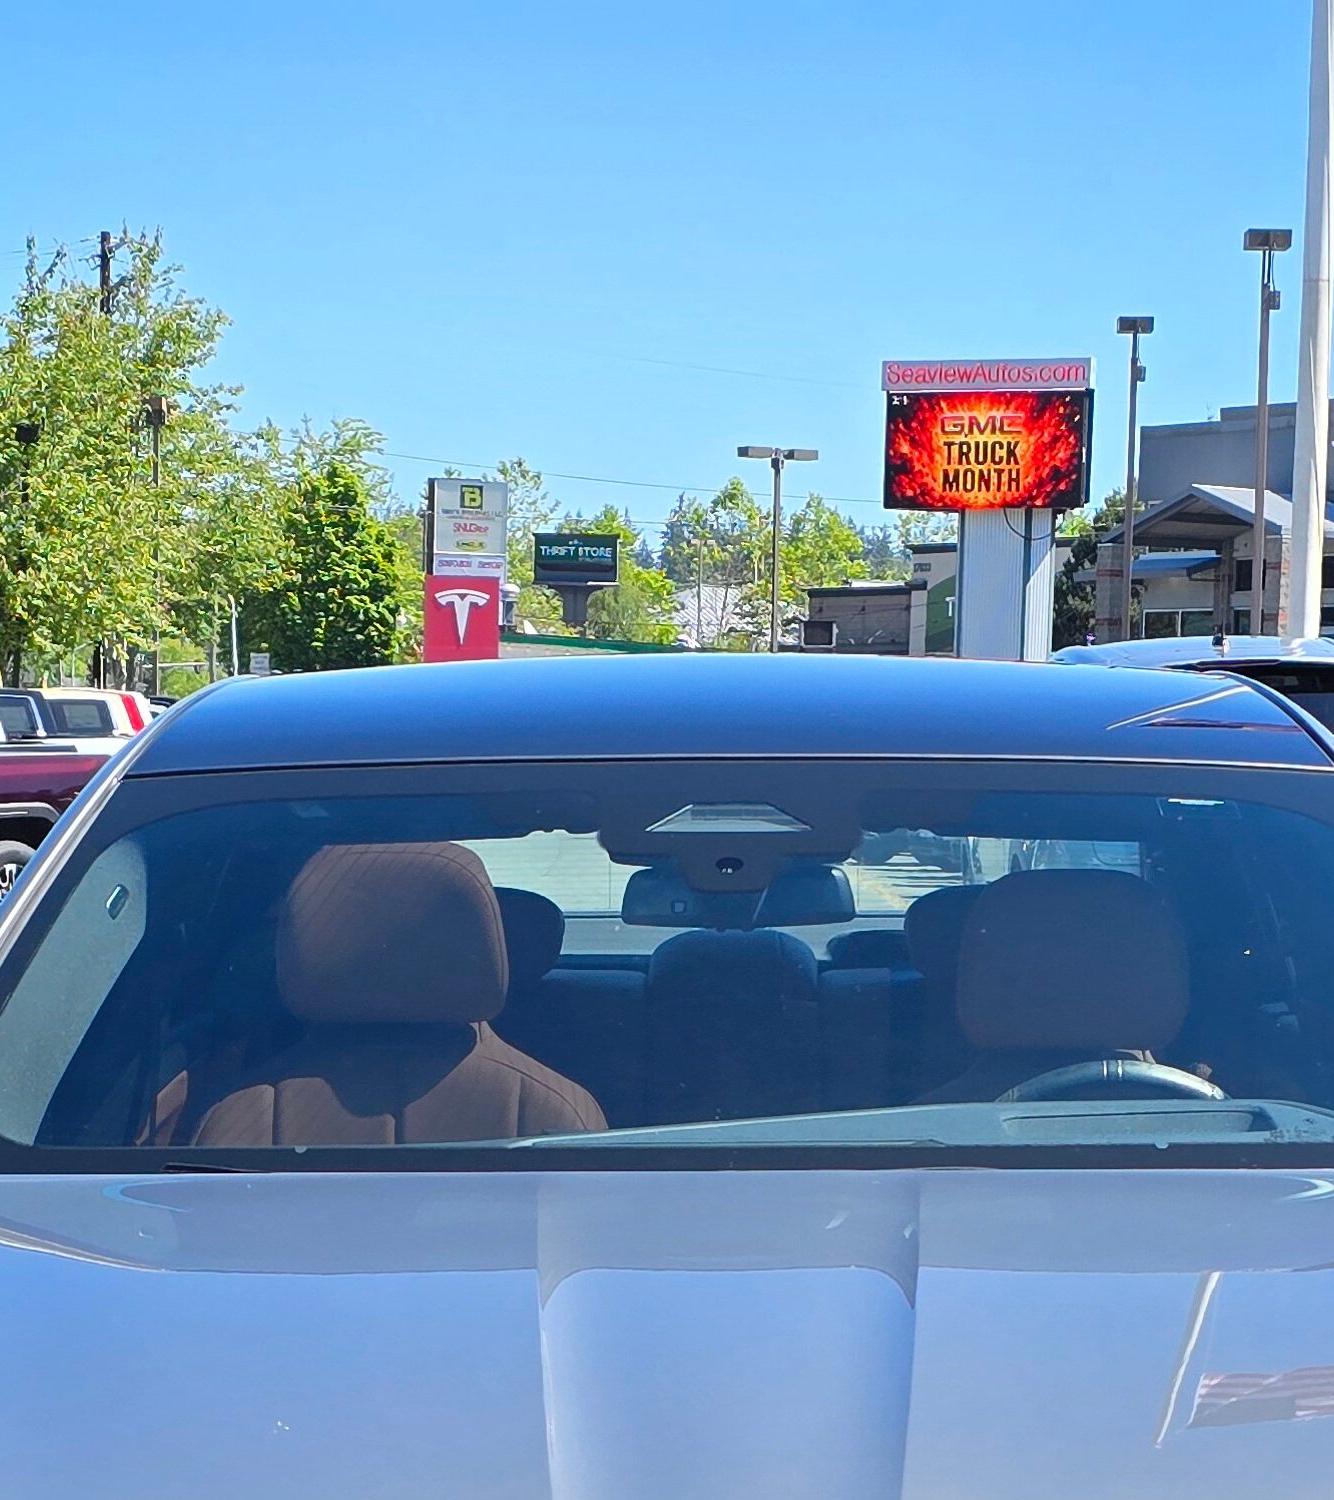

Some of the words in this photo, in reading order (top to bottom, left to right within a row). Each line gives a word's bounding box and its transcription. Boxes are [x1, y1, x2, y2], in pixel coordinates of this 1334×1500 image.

[886, 362, 1087, 385] SeaviewAutos.com
[939, 415, 1023, 435] GMC
[942, 440, 1021, 466] TRUCK
[941, 467, 1021, 493] MONTH
